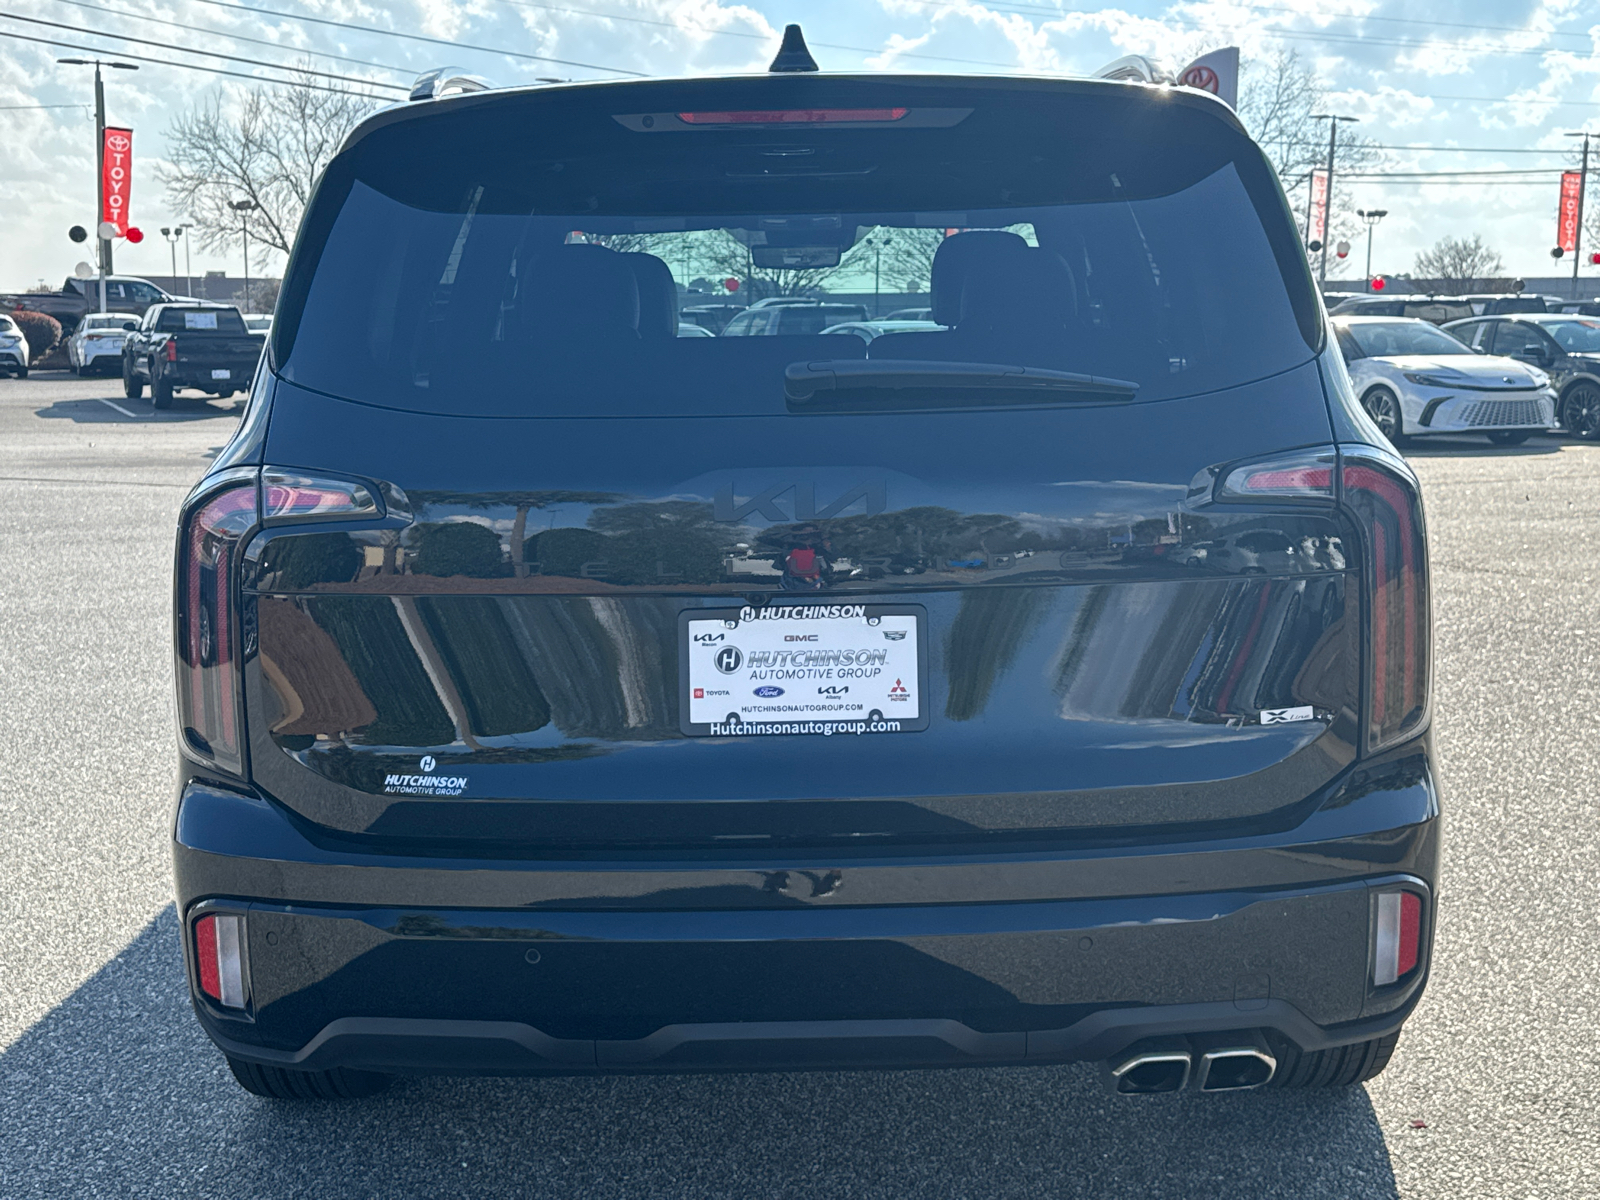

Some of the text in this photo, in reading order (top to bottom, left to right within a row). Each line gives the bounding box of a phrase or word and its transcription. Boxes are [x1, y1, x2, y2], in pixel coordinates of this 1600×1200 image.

[1315, 188, 1326, 238] TOYOT
[1565, 190, 1576, 249] TOYOTA
[713, 480, 887, 522] KIA
[759, 605, 866, 620] HUTCHINSON
[784, 634, 819, 642] GMC
[747, 649, 887, 668] HUTCHINSON
[750, 668, 881, 680] AUTOMOTIVE GROUP
[759, 687, 779, 697] Ford
[741, 704, 863, 713] HUTCHINSONAUTOGROUP.COM
[710, 721, 901, 736] Hutchinsonautogroup.com
[384, 774, 467, 789] HUTCHINSON
[384, 786, 462, 796] AUTOMOTIVE GROUP
